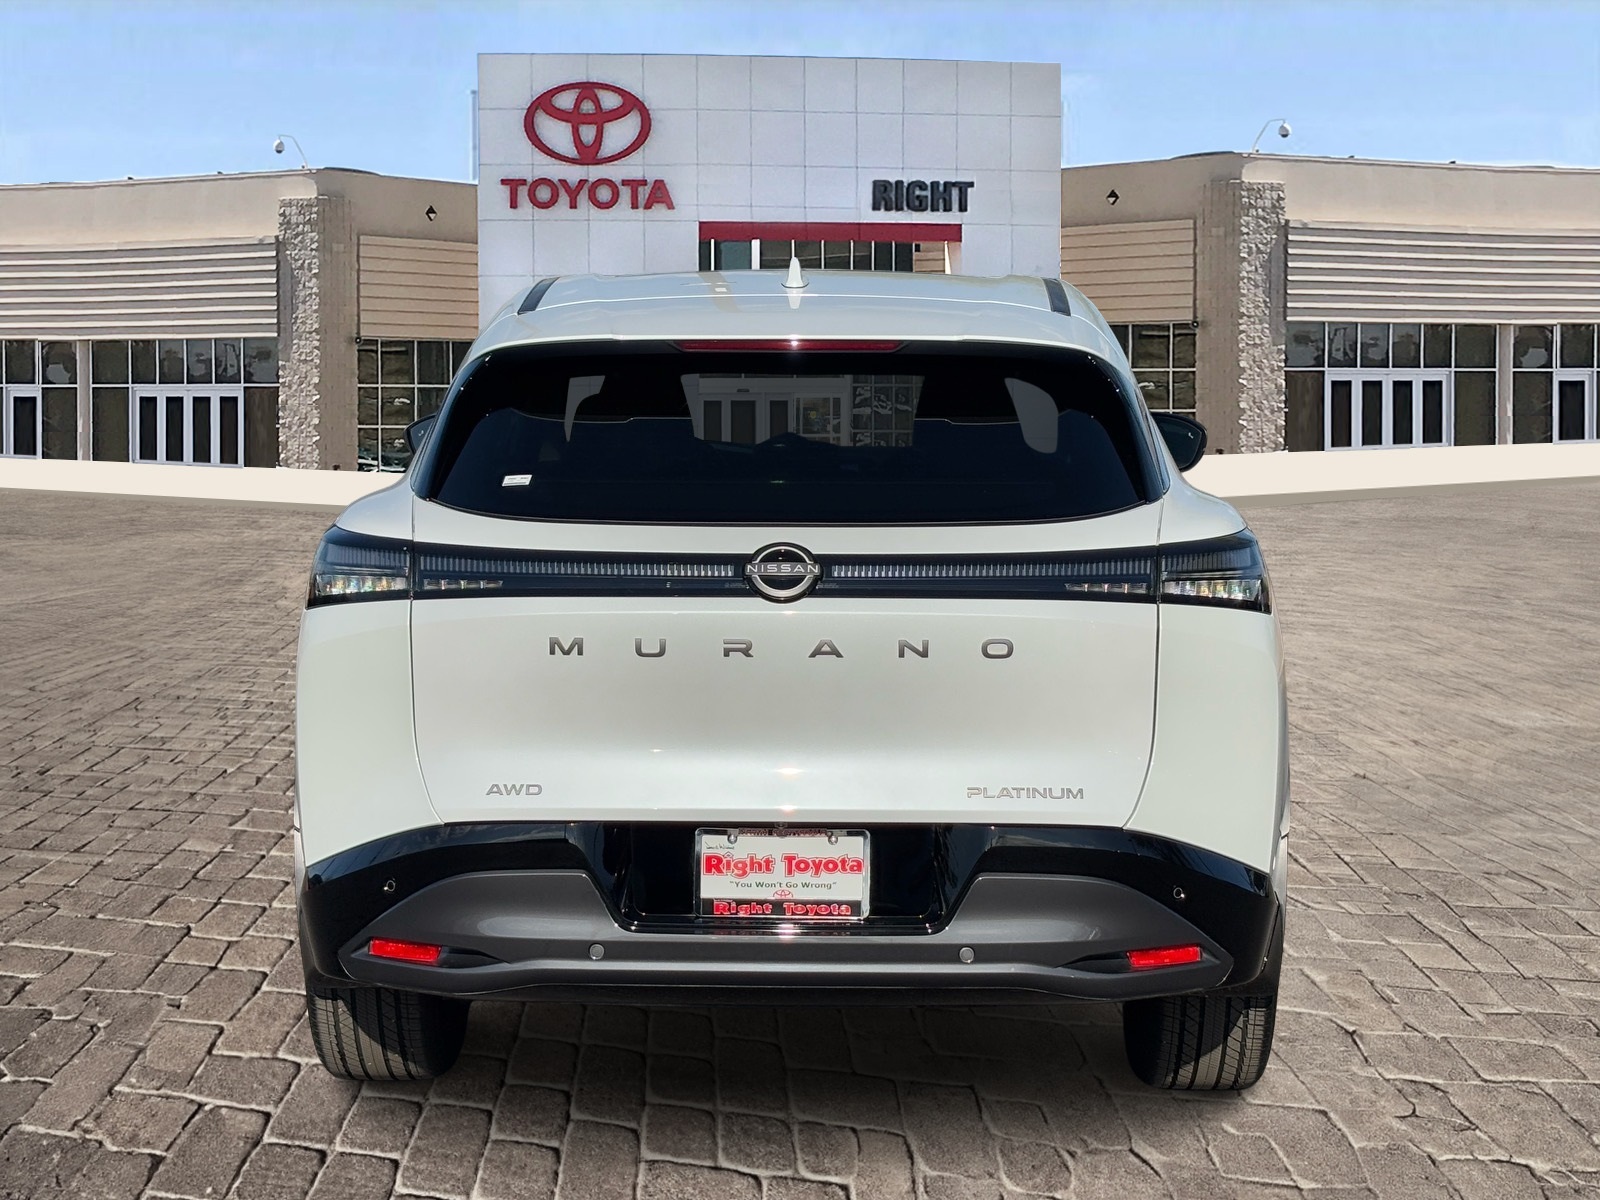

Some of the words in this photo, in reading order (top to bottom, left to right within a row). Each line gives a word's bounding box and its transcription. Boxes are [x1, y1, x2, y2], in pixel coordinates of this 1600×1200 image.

[501, 178, 675, 210] TOYOTA
[872, 179, 975, 212] RIGHT
[746, 564, 820, 574] NISSAN
[549, 636, 1015, 660] MURANO
[485, 783, 543, 796] AWD
[966, 786, 1085, 800] PLATINUM
[703, 852, 775, 878] Right
[781, 853, 864, 878] Toyota
[755, 881, 782, 889] Won't
[785, 881, 798, 889] Go
[713, 901, 773, 916] Right
[783, 902, 851, 916] Toyota
